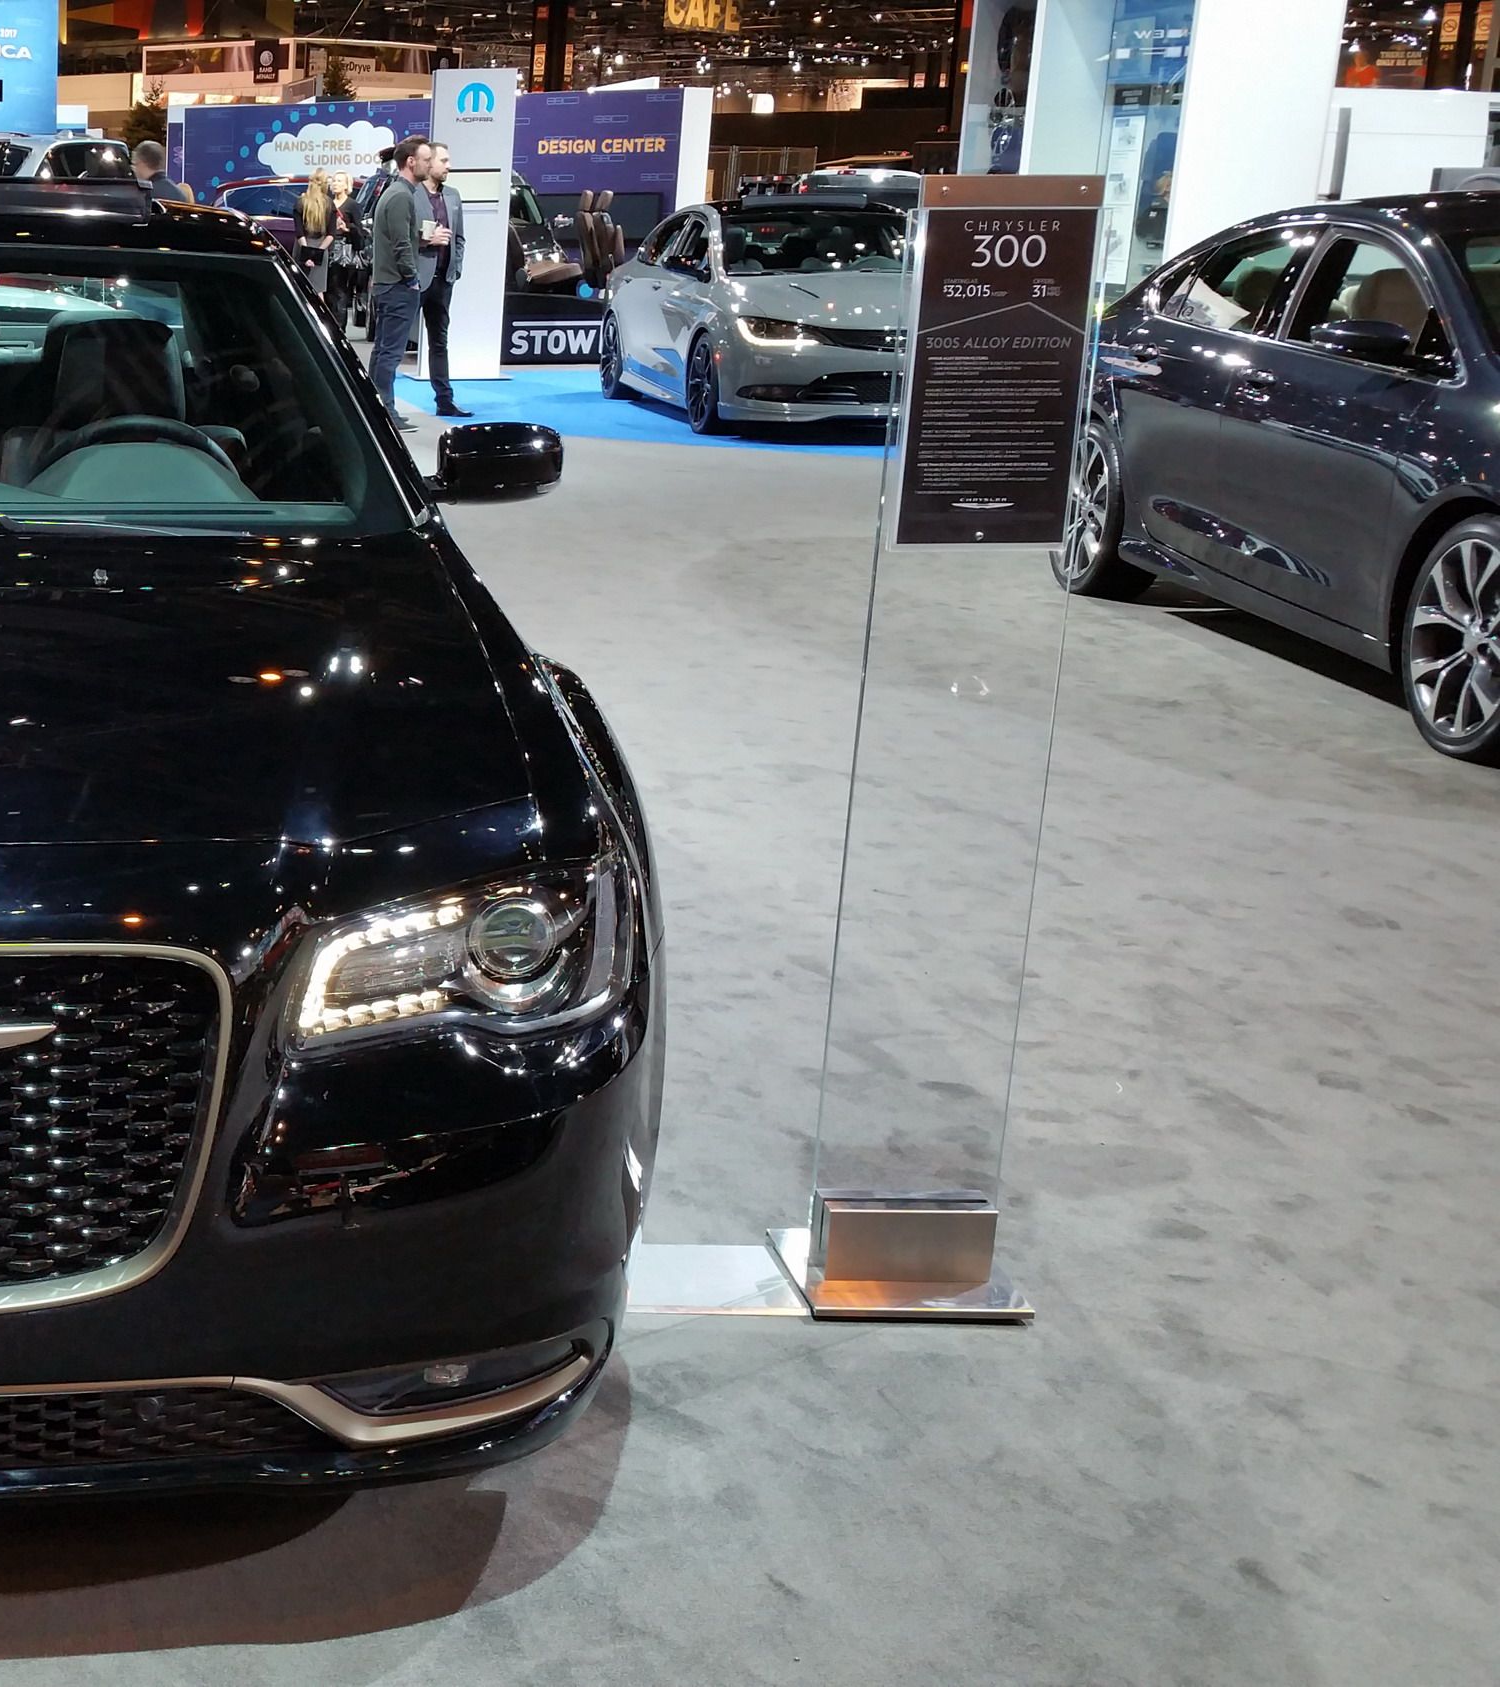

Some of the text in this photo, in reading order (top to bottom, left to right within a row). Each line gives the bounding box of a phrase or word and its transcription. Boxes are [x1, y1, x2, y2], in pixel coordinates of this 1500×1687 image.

[668, 0, 741, 31] CAFE
[0, 26, 18, 38] 2017
[275, 140, 352, 152] HANDS-FREE
[537, 138, 666, 155] DESIGN CENTER
[304, 153, 382, 165] SLIDING DOO
[964, 220, 1061, 232] CHRYSLER
[971, 234, 1047, 267] 300
[943, 284, 991, 298] $32,015
[1032, 285, 1046, 297] 31
[509, 329, 597, 354] STOW
[926, 337, 1072, 348] 300S ALLOY EDITION
